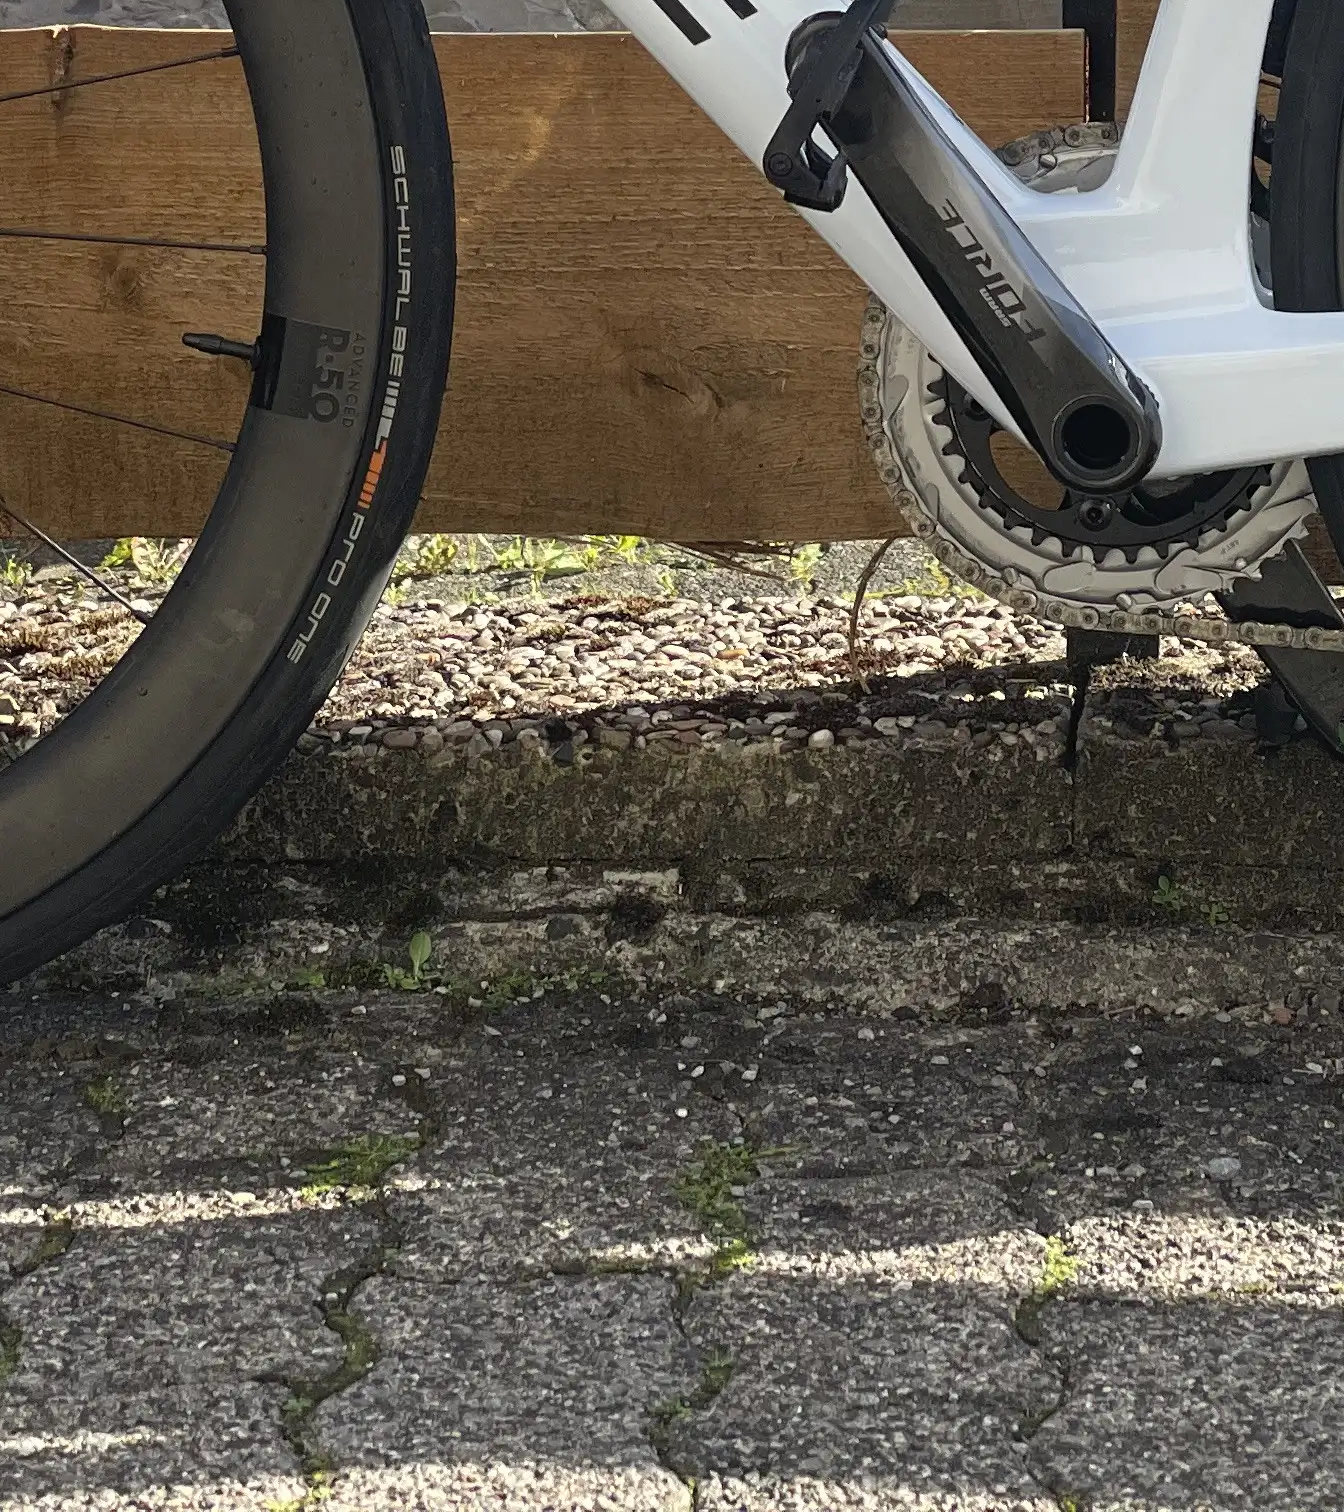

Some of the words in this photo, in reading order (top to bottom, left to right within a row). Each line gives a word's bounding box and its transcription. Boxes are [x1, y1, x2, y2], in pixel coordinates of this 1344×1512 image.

[388, 144, 412, 378] SCHWALBE
[940, 198, 1047, 342] FORCE
[341, 331, 367, 428] ADVANCED
